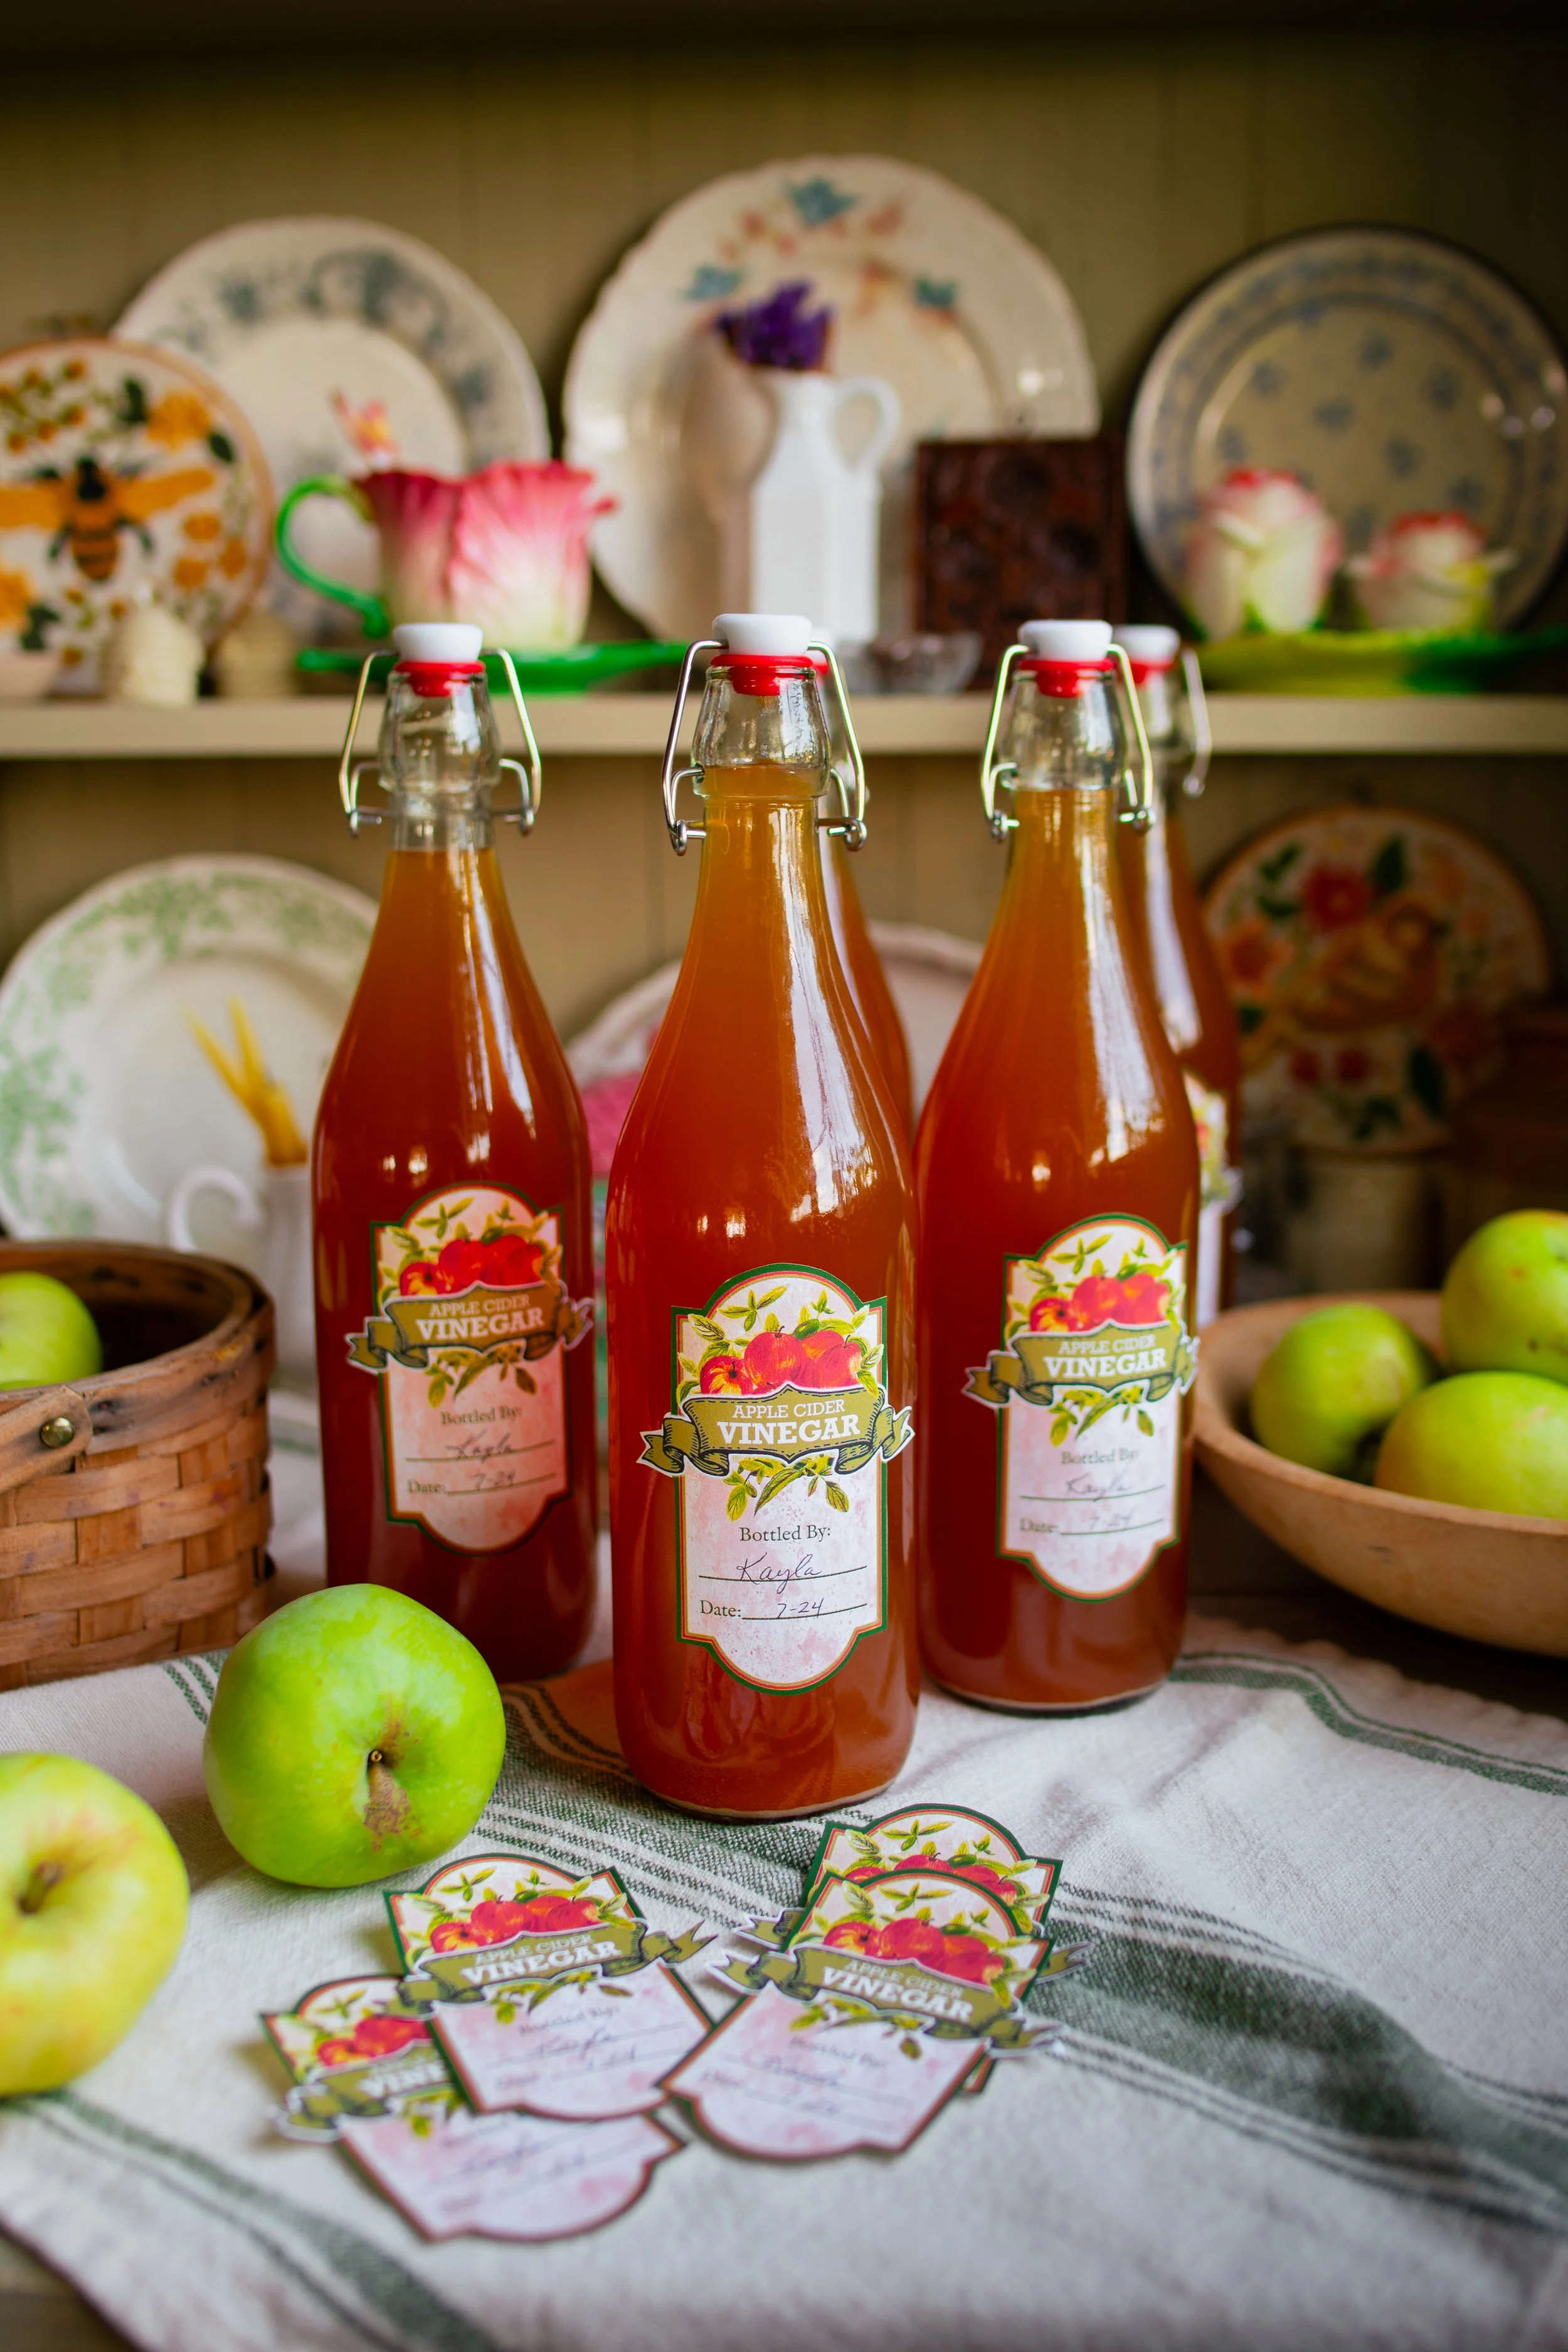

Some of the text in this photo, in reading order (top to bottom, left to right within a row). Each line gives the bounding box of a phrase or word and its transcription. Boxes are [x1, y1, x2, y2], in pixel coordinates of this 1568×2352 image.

[429, 1294, 530, 1318] APPLE CIDER
[415, 1307, 544, 1340] VINEGAR
[1058, 1334, 1156, 1355] APPLE CIDER
[1043, 1348, 1166, 1378] VINEGAR
[440, 1405, 523, 1426] Bottled By:
[732, 1399, 845, 1419] APPLE CIDER
[717, 1414, 861, 1444] VINEGAR
[1061, 1449, 1115, 1465] Bottled
[407, 1479, 447, 1495] Date:
[739, 1525, 830, 1542] Bottled By:
[1019, 1518, 1059, 1533] Date:
[736, 1552, 824, 1594] Kayla
[700, 1600, 742, 1618] Date:
[776, 1598, 824, 1618] 7-24
[474, 1934, 595, 1966] APPLE CIDER
[460, 1941, 622, 1986] VINEGAR
[822, 1966, 973, 2023] VINEGAR
